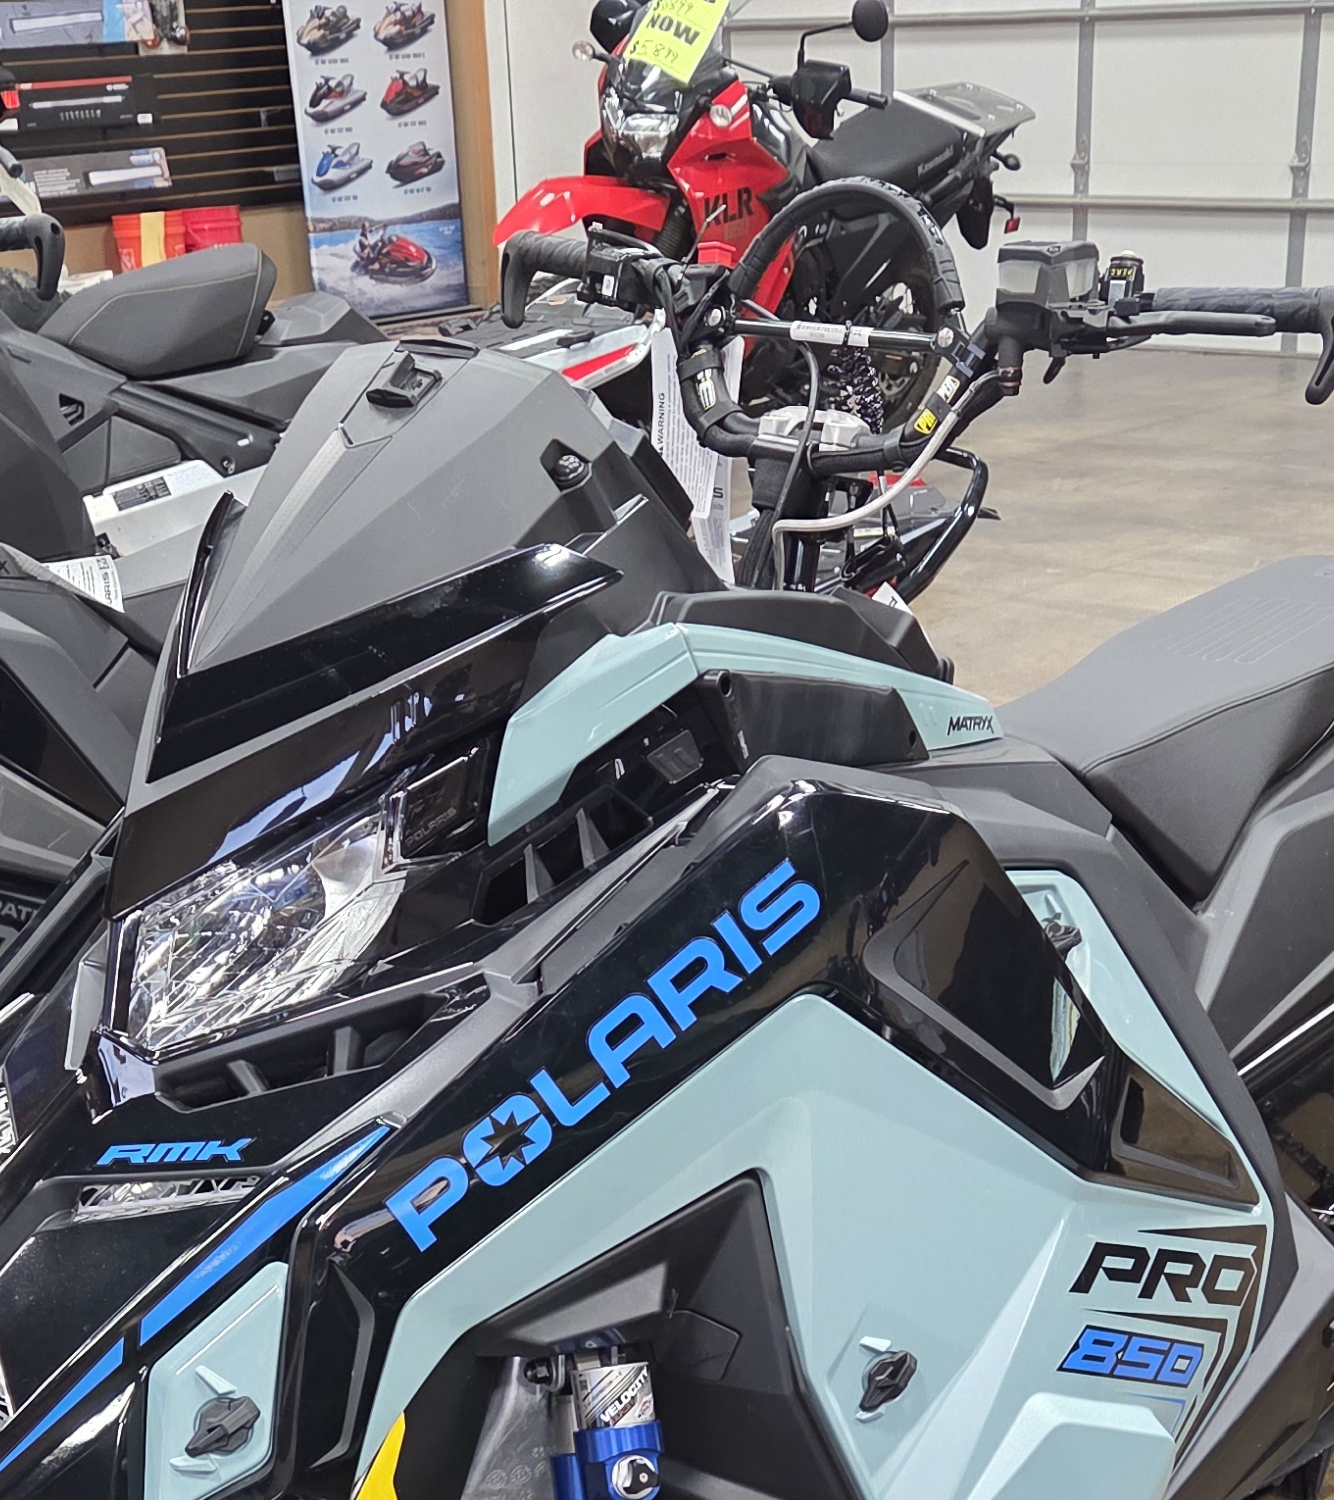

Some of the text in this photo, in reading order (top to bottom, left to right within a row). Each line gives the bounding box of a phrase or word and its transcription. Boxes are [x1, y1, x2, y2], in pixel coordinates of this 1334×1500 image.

[646, 13, 701, 46] NOW
[704, 187, 754, 227] KLR
[657, 393, 665, 444] WARNING
[947, 715, 995, 736] MATRYX
[385, 857, 821, 1252] POLARIS
[95, 1137, 254, 1167] RMK
[1068, 1241, 1256, 1307] PRO
[1056, 1324, 1205, 1389] 850
[599, 1365, 649, 1423] VELOCITY
